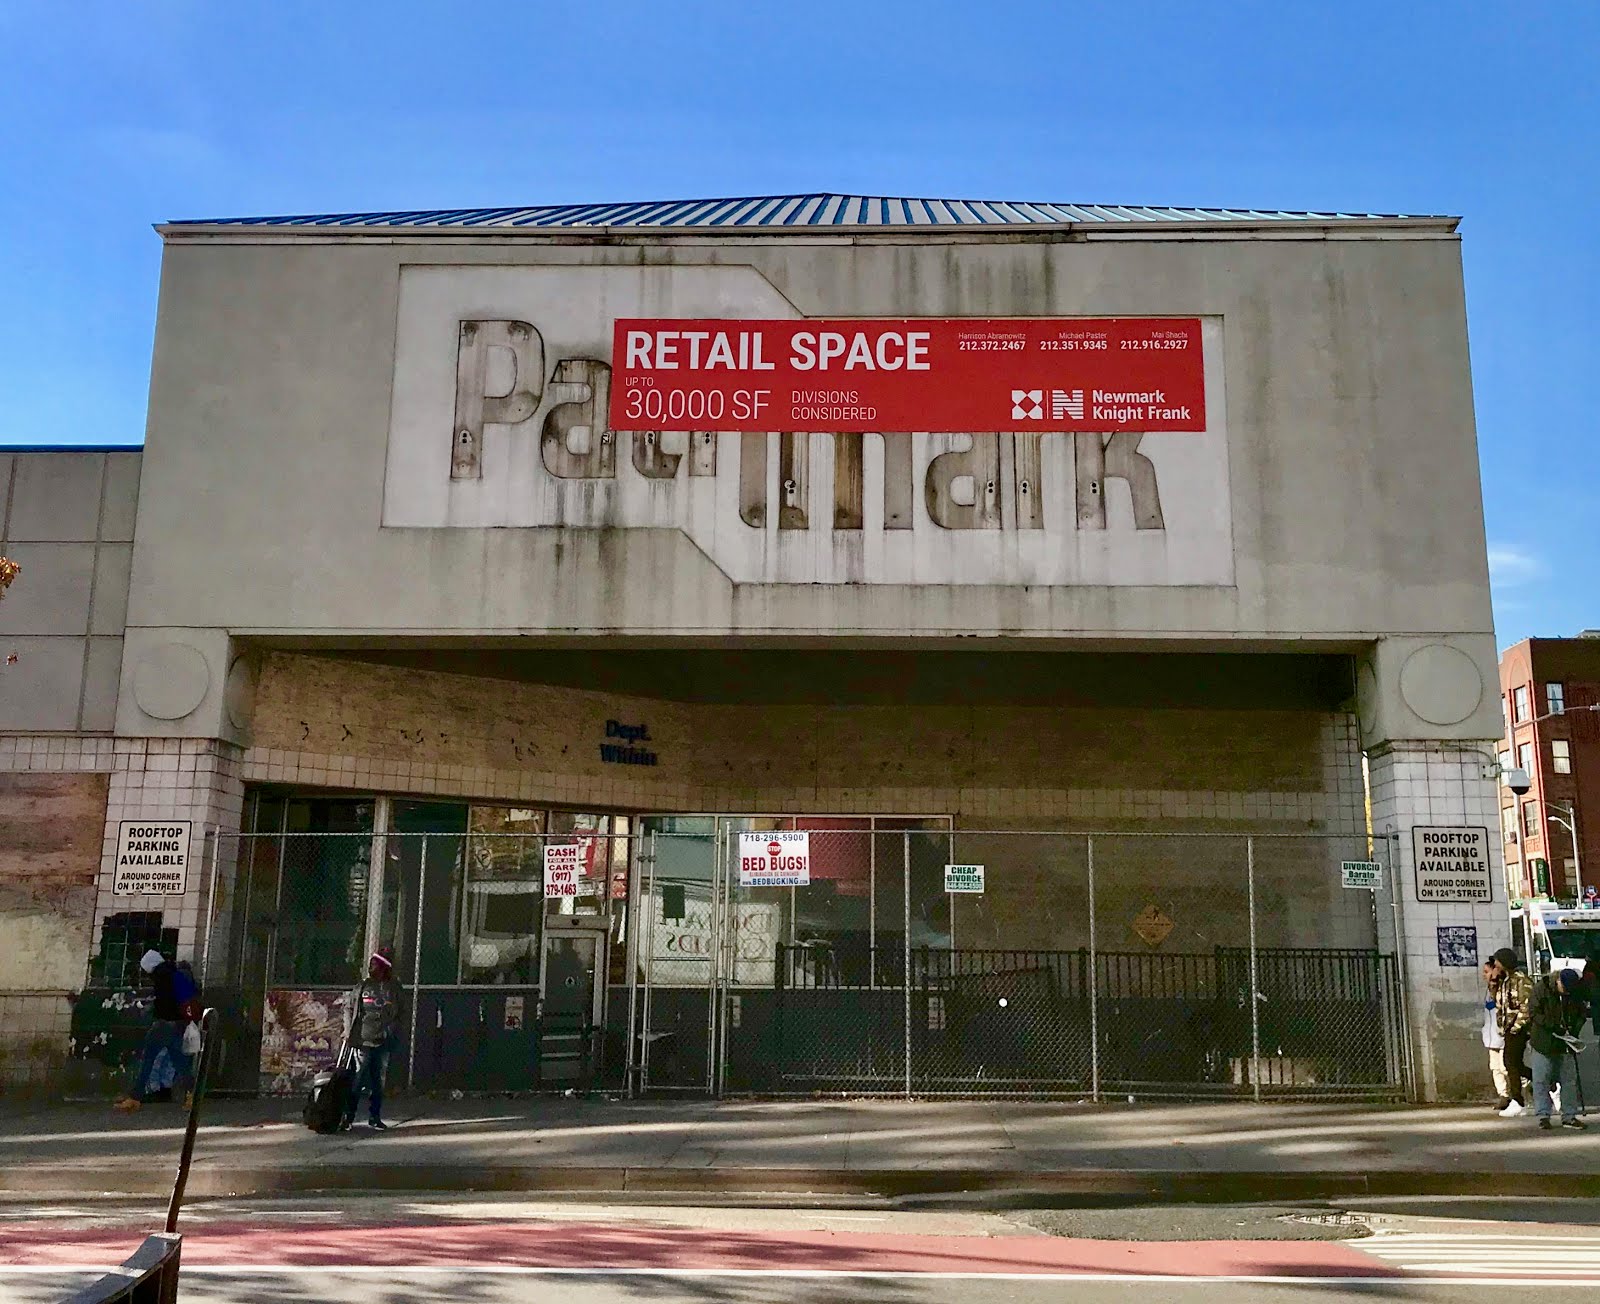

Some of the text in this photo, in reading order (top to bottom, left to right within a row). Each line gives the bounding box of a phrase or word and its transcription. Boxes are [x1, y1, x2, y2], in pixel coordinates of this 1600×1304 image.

[959, 341, 1026, 350] 212.372.2467
[1040, 340, 1107, 350] 212.351.9345
[1120, 340, 1188, 350] 212.916.2927
[625, 331, 931, 371] RETAIL SPACE
[625, 377, 654, 387] UP TO
[791, 390, 859, 404] DIVISIONS
[1092, 389, 1165, 403] Newmark
[625, 389, 771, 424] 30,000 SF
[791, 406, 877, 420] CONSIDERED
[1092, 405, 1191, 424] Knight Frank
[129, 827, 183, 838] ROOFTOP
[744, 834, 804, 842] 718-296-5900
[1423, 833, 1479, 844] ROOFTOP
[127, 841, 180, 851] PARKING
[1424, 847, 1478, 858] PARKING
[120, 855, 184, 865] AVAILABLE
[742, 856, 807, 871] BED BUGS!
[951, 866, 977, 874] CHEAP
[1343, 862, 1380, 871] DIVORCIO
[1419, 861, 1485, 872] AVAILABLE
[121, 872, 181, 880] AROUND CORNER
[552, 871, 572, 883] (917)
[946, 874, 982, 882] DIVORCE
[1348, 871, 1375, 879] Barato
[117, 882, 129, 890] ON
[152, 882, 182, 891] STREET
[1423, 879, 1485, 887] AROUND CORNER
[546, 883, 577, 896] 379-1463
[1421, 889, 1433, 897] ON
[1456, 889, 1488, 898] STREET
